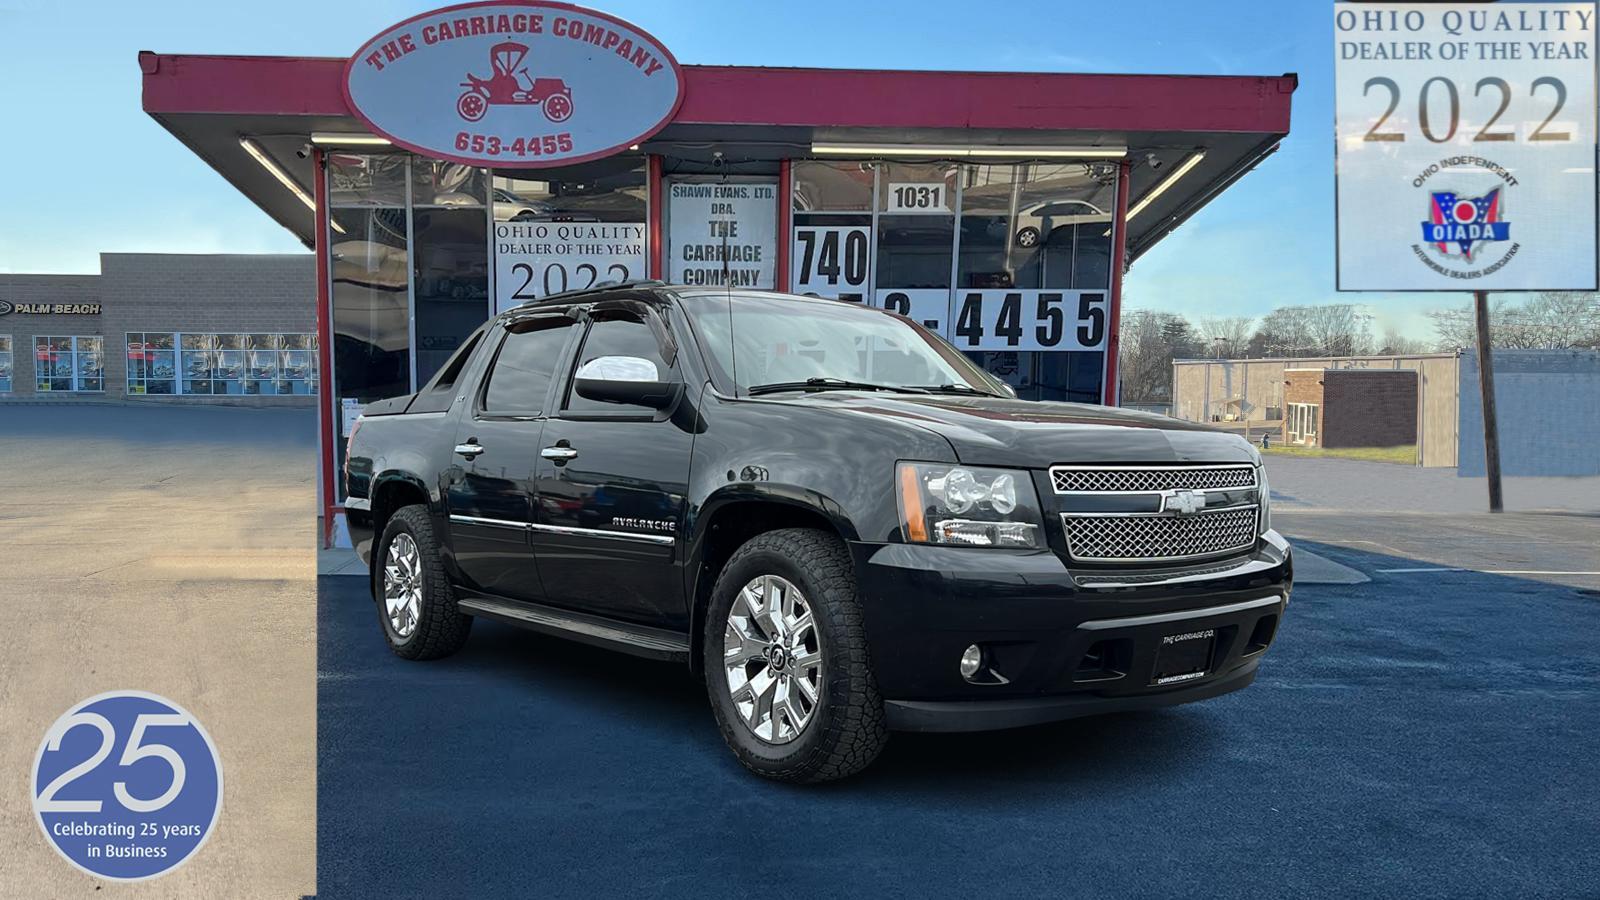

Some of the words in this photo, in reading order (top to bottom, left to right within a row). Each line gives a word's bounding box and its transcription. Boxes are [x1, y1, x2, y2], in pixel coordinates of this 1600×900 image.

[1337, 10, 1424, 31] OHIO
[1442, 10, 1593, 35] QUALITY
[365, 33, 416, 71] THE
[422, 14, 544, 46] CARRIAGE
[553, 17, 664, 77] COMPANY
[1340, 42, 1433, 60] DEALER
[1439, 42, 1470, 60] OF
[1475, 42, 1521, 60] THE
[1528, 42, 1589, 60] YEAR
[1363, 76, 1571, 143] 2022
[455, 132, 573, 156] 653-4455
[1412, 164, 1439, 188] OHIO
[1440, 155, 1519, 187] INDEPENDENT
[673, 186, 711, 198] SHAWN
[754, 187, 775, 199] LTD.
[895, 186, 940, 208] 1031
[711, 203, 736, 215] DBA.
[497, 226, 548, 239] OHIO
[557, 226, 644, 241] QUALITY
[708, 220, 738, 238] THE
[1433, 225, 1495, 240] OIADA
[500, 244, 552, 255] DEALER
[555, 244, 573, 255] OF
[576, 244, 603, 255] THE
[605, 244, 642, 256] YEAR
[797, 230, 868, 286] 740
[15, 304, 51, 313] PALM
[54, 304, 100, 314] BEACH
[612, 516, 676, 531] AVALANCHE
[1163, 635, 1175, 645] THE
[1175, 630, 1204, 642] CARRIAGE
